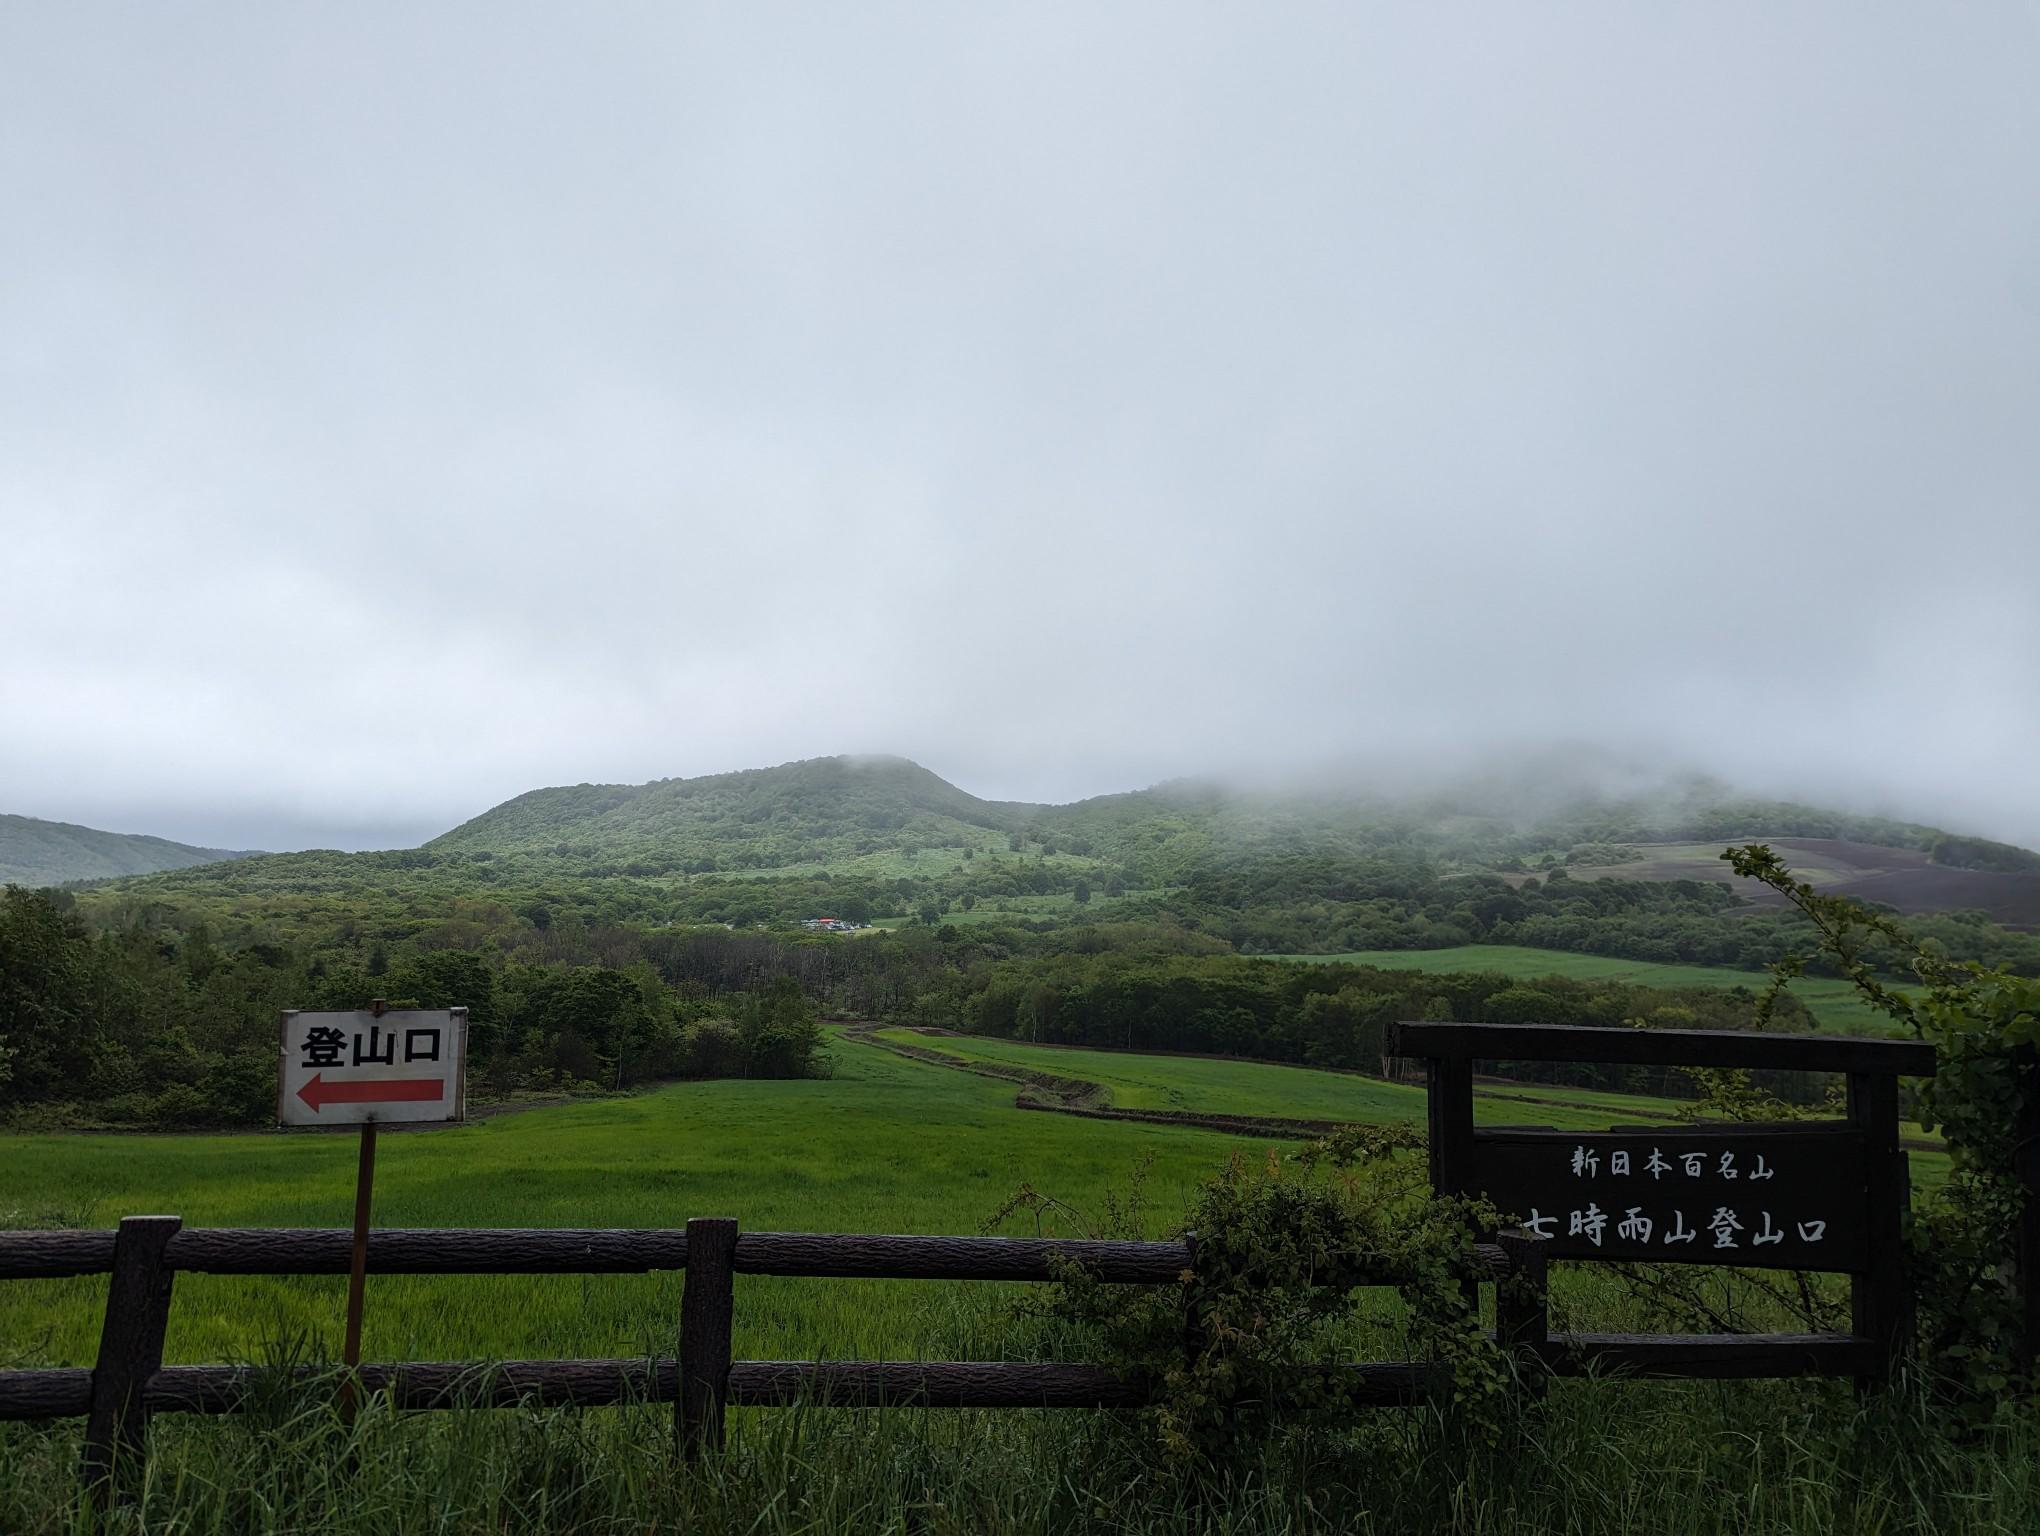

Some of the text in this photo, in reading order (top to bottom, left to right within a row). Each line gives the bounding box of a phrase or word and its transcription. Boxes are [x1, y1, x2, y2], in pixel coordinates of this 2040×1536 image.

[301, 1026, 440, 1068] 登山口
[1570, 1145, 1774, 1181] 新日本百名山
[1520, 1202, 1827, 1248] 七時雨山登山口
